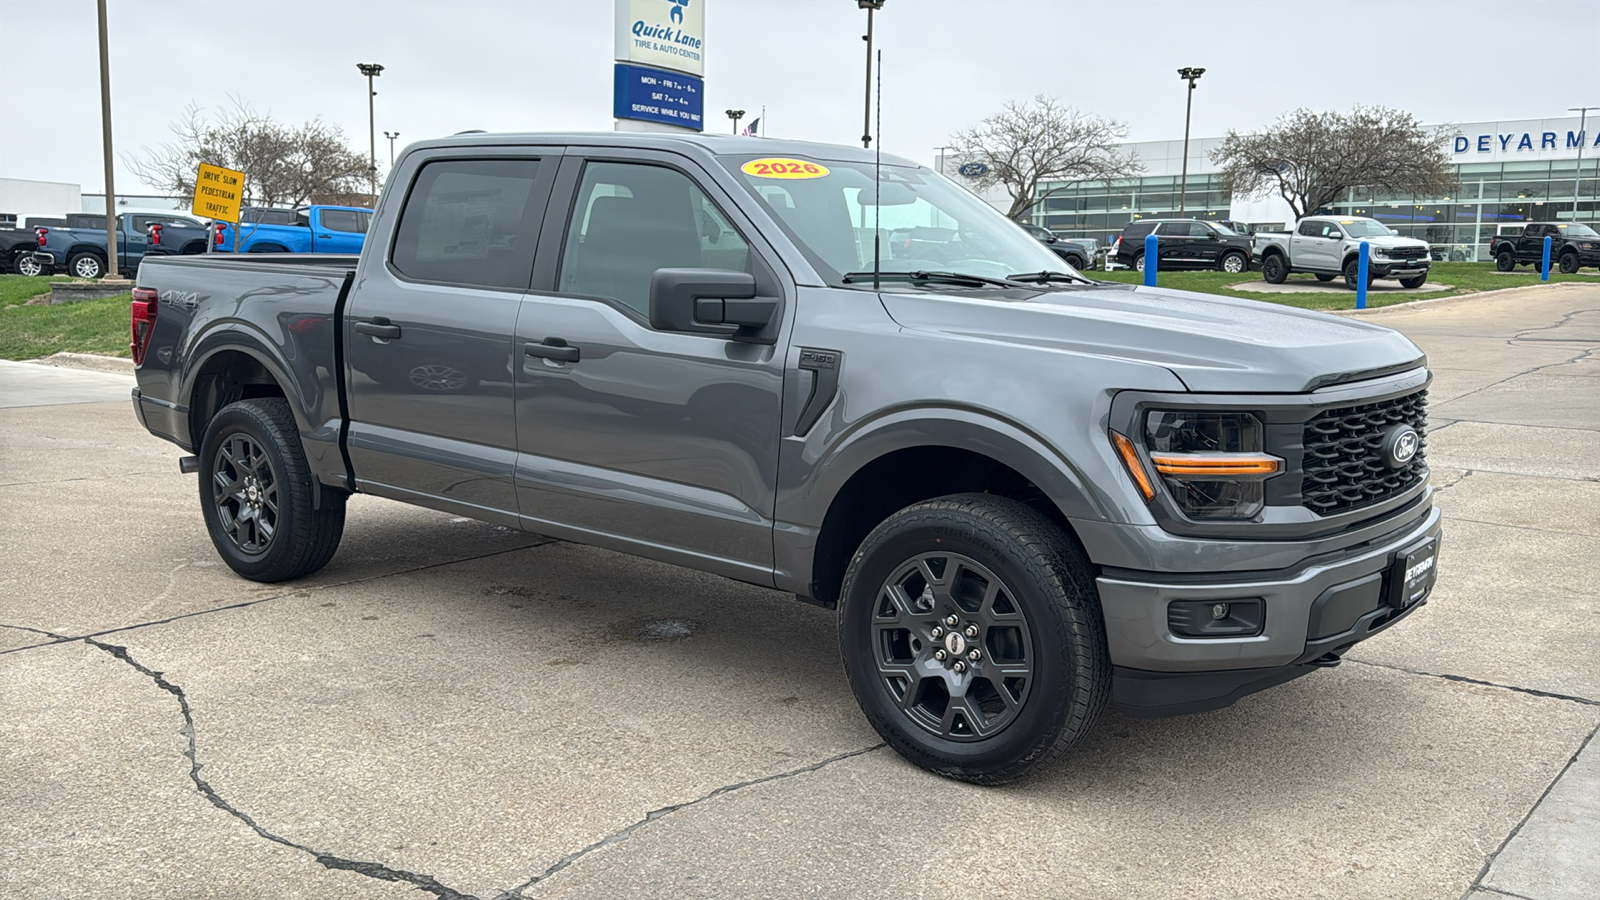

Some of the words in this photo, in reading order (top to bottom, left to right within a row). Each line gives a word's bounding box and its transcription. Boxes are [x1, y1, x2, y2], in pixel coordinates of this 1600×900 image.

[632, 20, 673, 41] Quick
[674, 29, 701, 49] Lane
[634, 39, 652, 49] TIRE
[659, 44, 678, 55] AUTO
[679, 48, 700, 61] CENTER
[641, 76, 656, 85] MON
[663, 80, 672, 88] FRI
[651, 92, 663, 100] SAT
[631, 103, 659, 114] SERVICE
[660, 107, 678, 117] WHILE
[679, 111, 689, 119] YOU
[753, 162, 820, 175] 2026
[203, 171, 220, 182] DRIVE
[222, 175, 238, 186] SLOW
[201, 185, 235, 200] PEDESTRIAN
[205, 202, 228, 215] TRAFFIC
